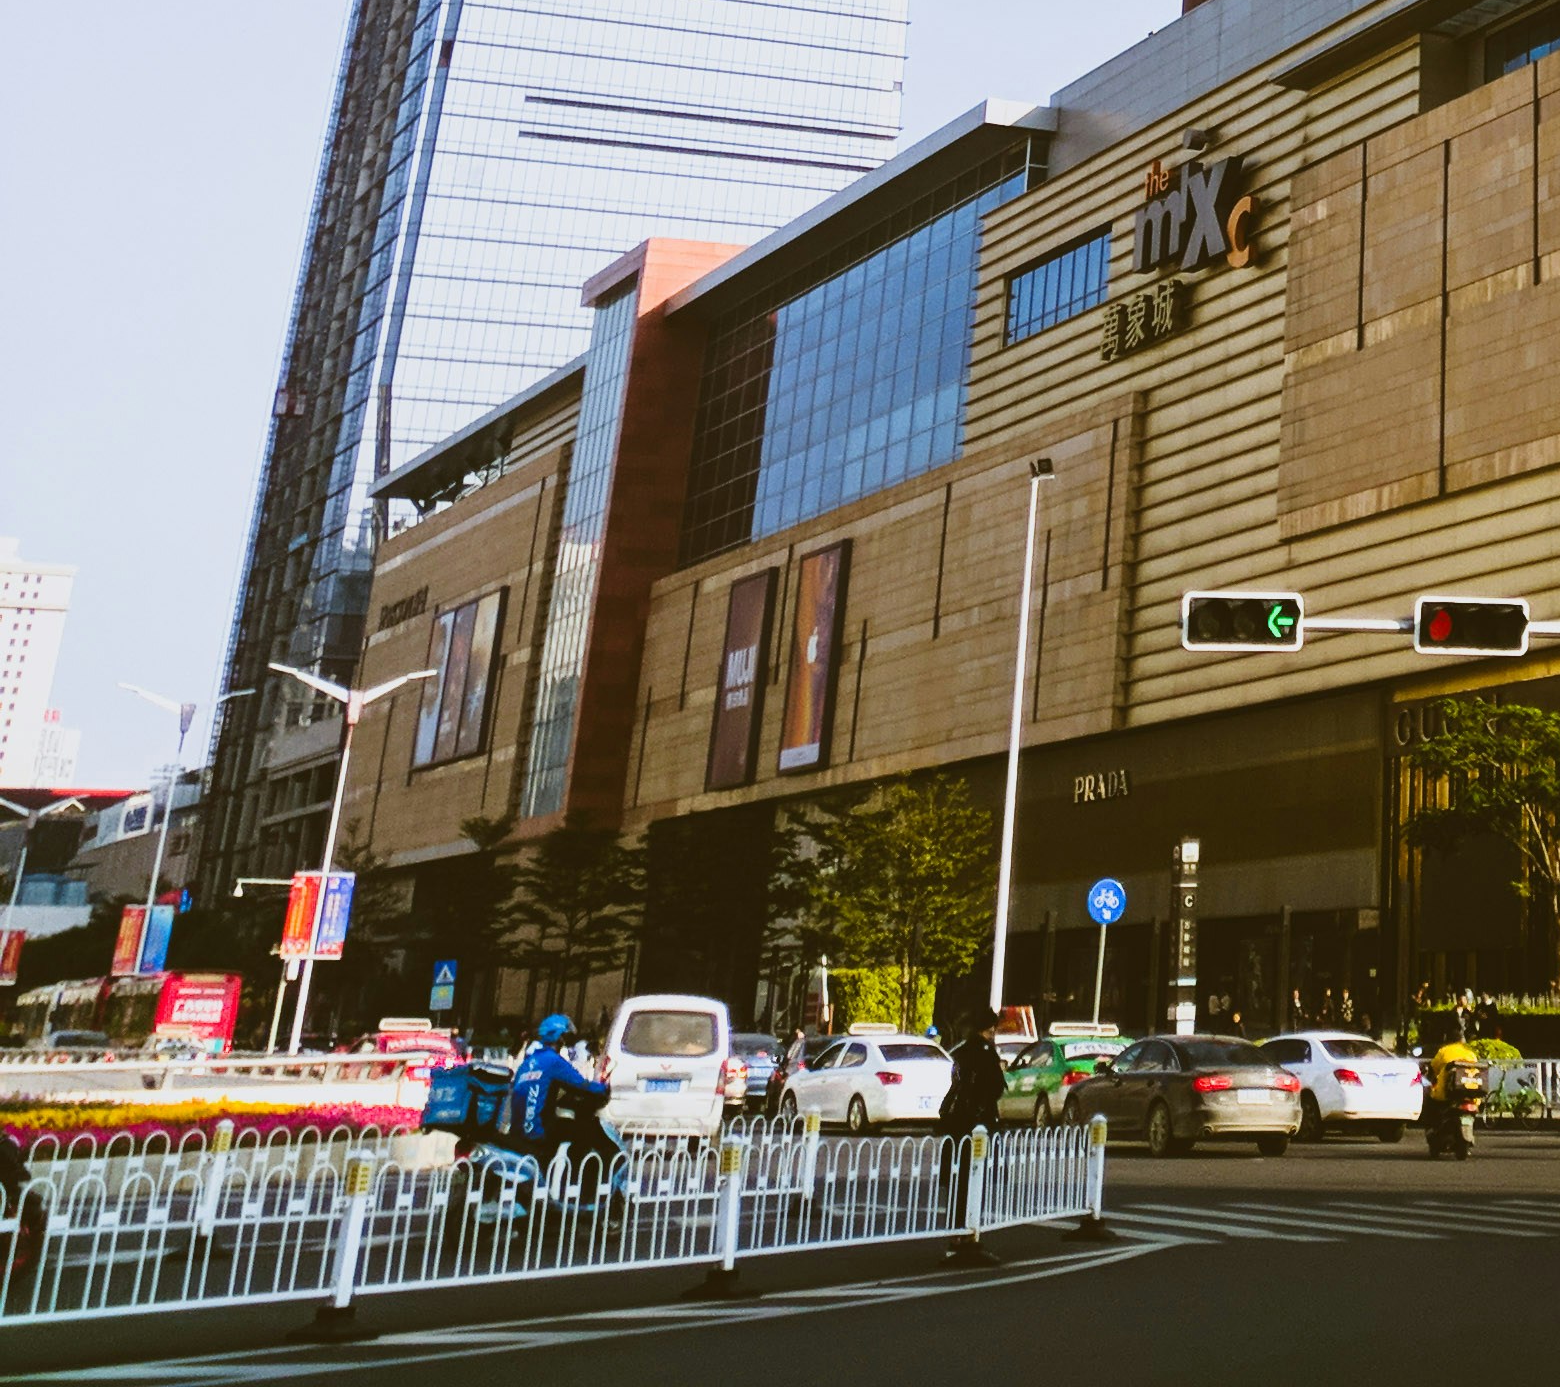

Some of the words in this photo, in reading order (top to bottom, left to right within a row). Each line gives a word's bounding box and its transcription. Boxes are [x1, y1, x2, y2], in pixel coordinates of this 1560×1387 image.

[1145, 161, 1170, 200] the
[1100, 280, 1180, 362] 萬象城
[1073, 769, 1128, 803] PRADA
[1184, 894, 1194, 908] C
